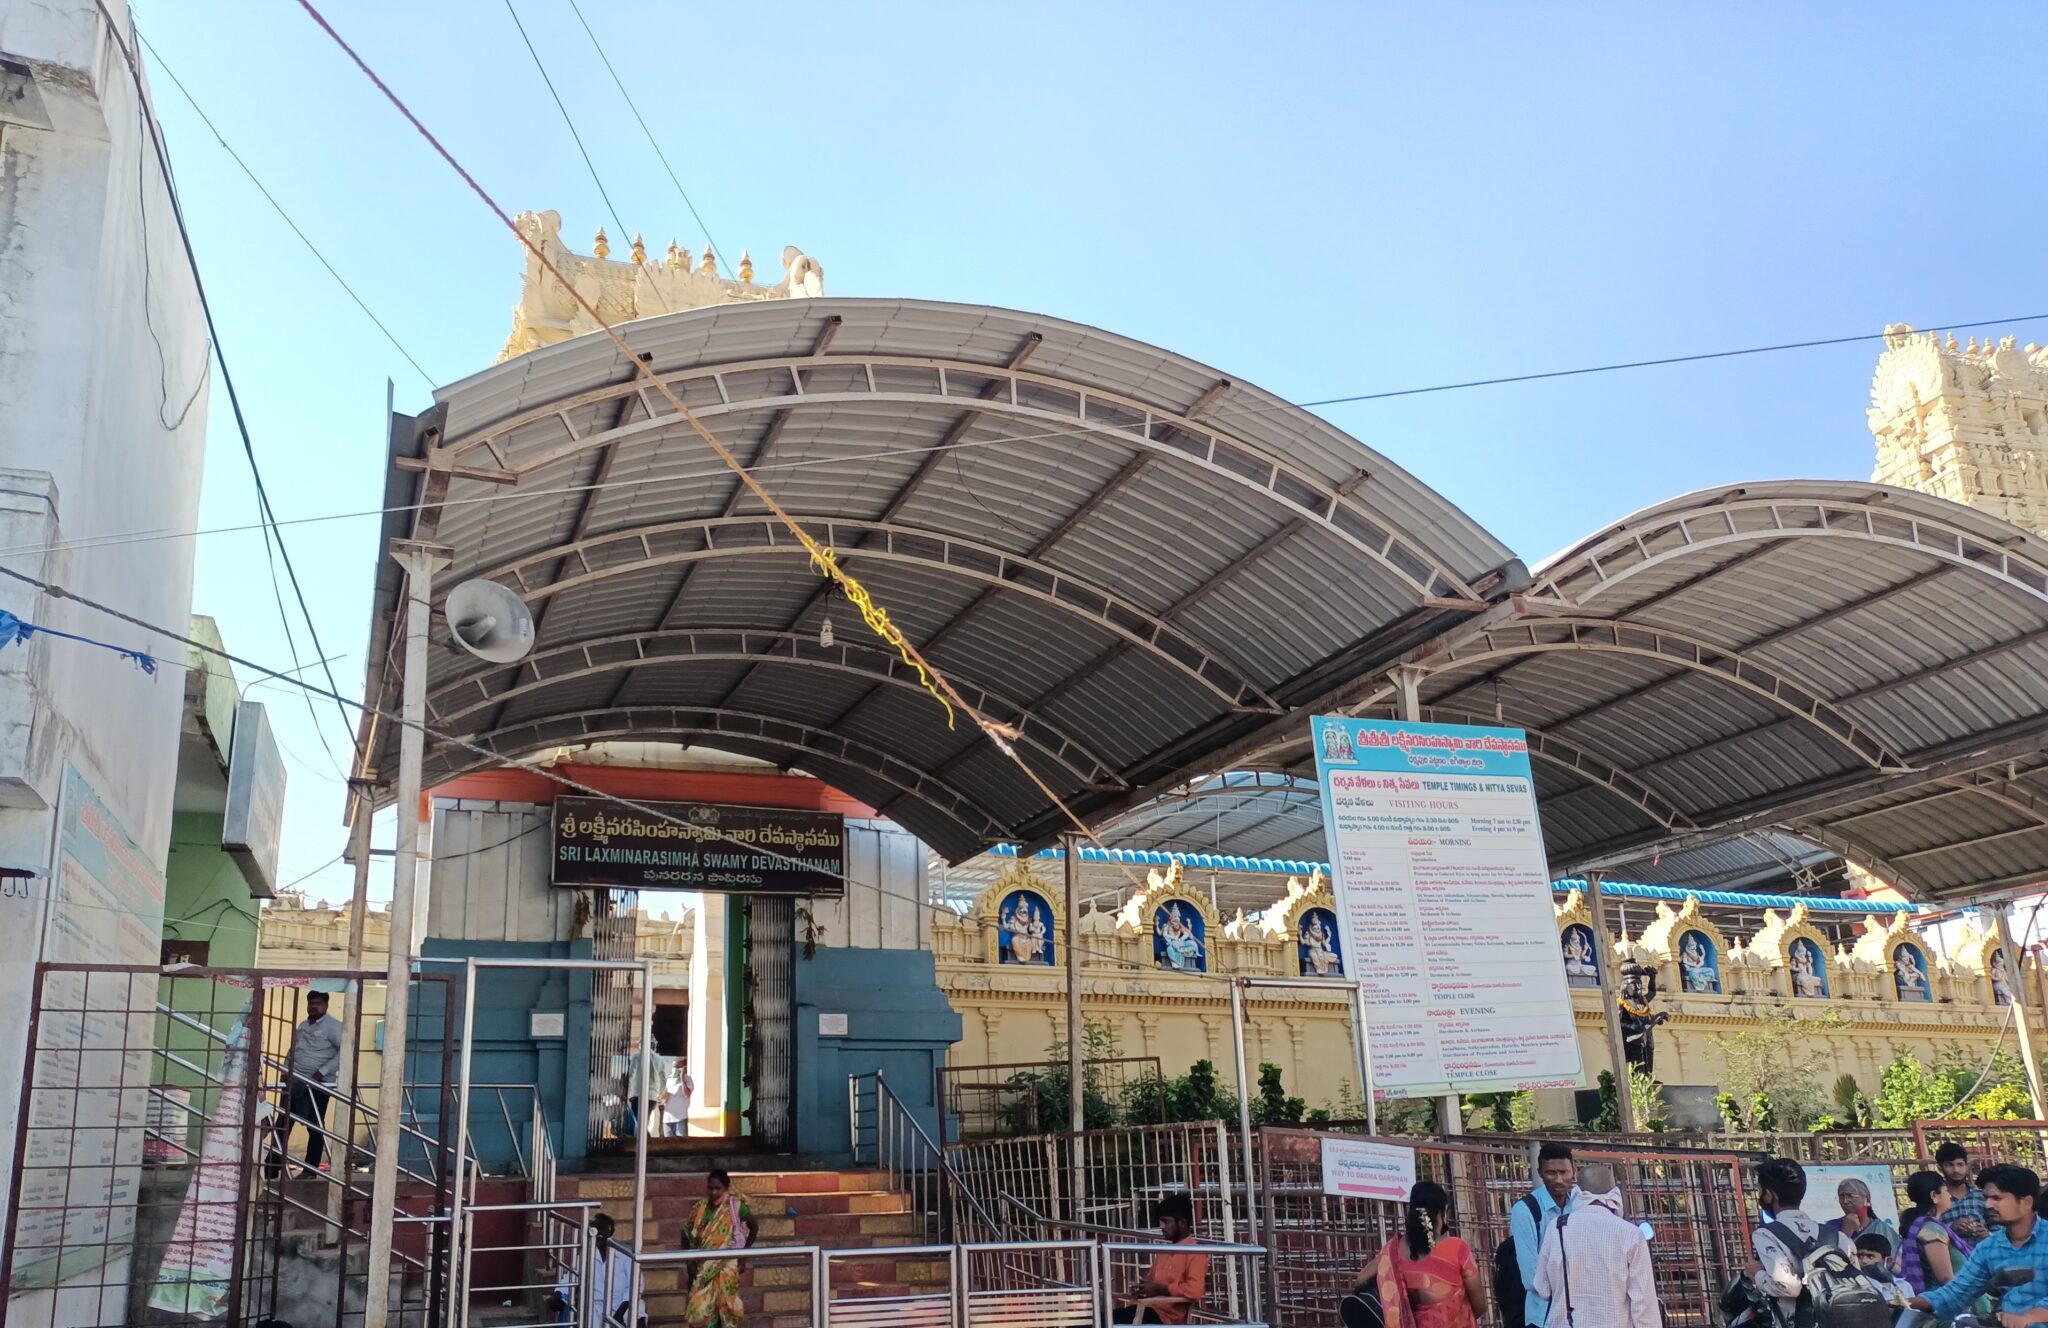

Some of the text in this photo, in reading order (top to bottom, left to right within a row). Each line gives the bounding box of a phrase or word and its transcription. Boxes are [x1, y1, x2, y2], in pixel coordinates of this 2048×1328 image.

[1464, 738, 1482, 749] వారి
[1421, 781, 1448, 791] TEMPLE
[1449, 781, 1478, 792] TIMINGS
[1478, 783, 1484, 792] &
[1484, 783, 1505, 793] NITYA
[1505, 783, 1527, 793] SEVAS
[1388, 799, 1459, 809] VISITING HOURS
[560, 812, 577, 838] శ్రీ
[725, 828, 756, 843] వారి
[760, 823, 840, 853] దేవస్థానము
[1438, 838, 1472, 846] MORNING
[560, 845, 840, 874] SRI LAXMINARASIMHA SWAMY DEVASTHANAM
[1458, 1006, 1496, 1015] EVENING
[1445, 1070, 1473, 1078] TEMPLE
[1332, 1170, 1345, 1178] WAY
[1356, 1172, 1377, 1180] DARMA
[1378, 1174, 1408, 1183] DARSHAN
